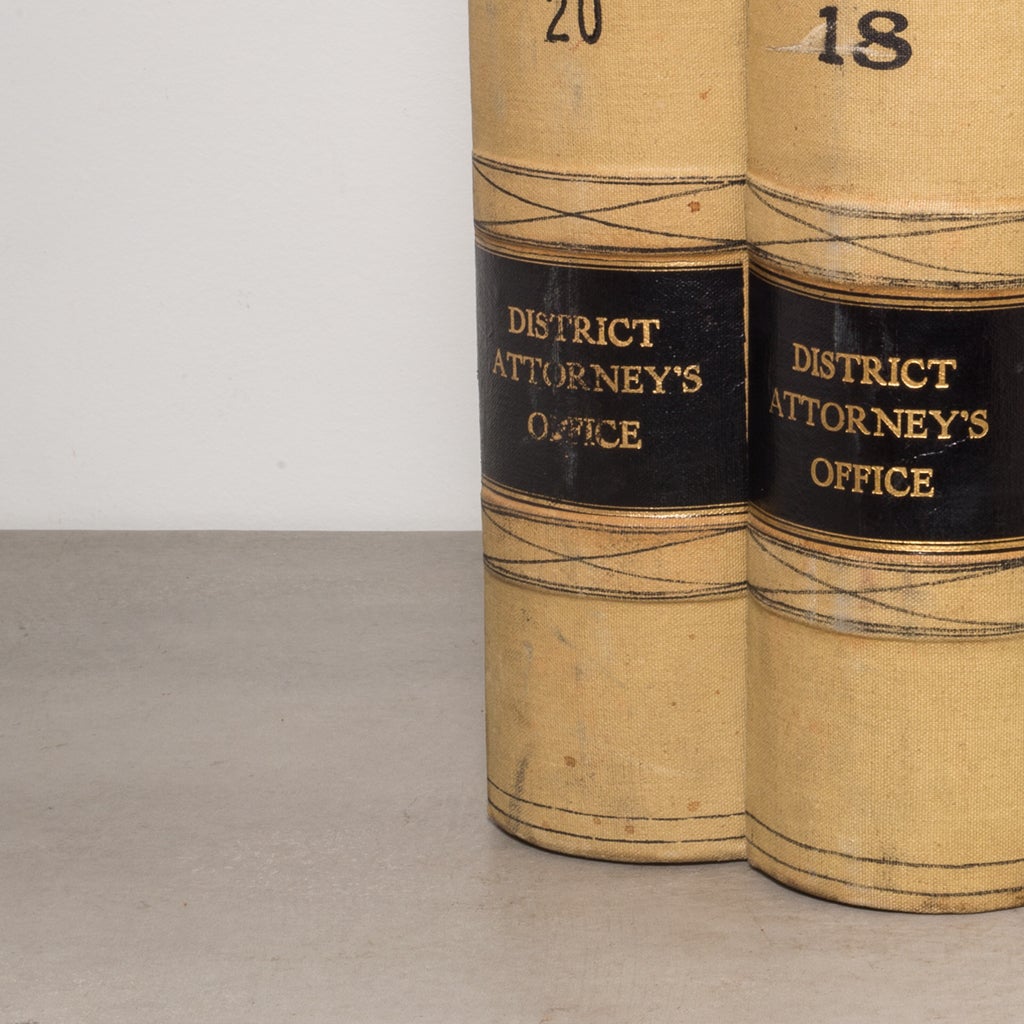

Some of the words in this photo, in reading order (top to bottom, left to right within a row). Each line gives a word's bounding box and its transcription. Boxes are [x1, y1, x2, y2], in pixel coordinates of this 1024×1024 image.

[817, 6, 913, 70] 18
[508, 306, 661, 348] DISTRICT
[492, 349, 703, 395] ATTORNEY'S
[792, 343, 957, 390] DISTRICT
[769, 387, 990, 441] ATTORNEY'S
[810, 457, 936, 499] OFFICE
